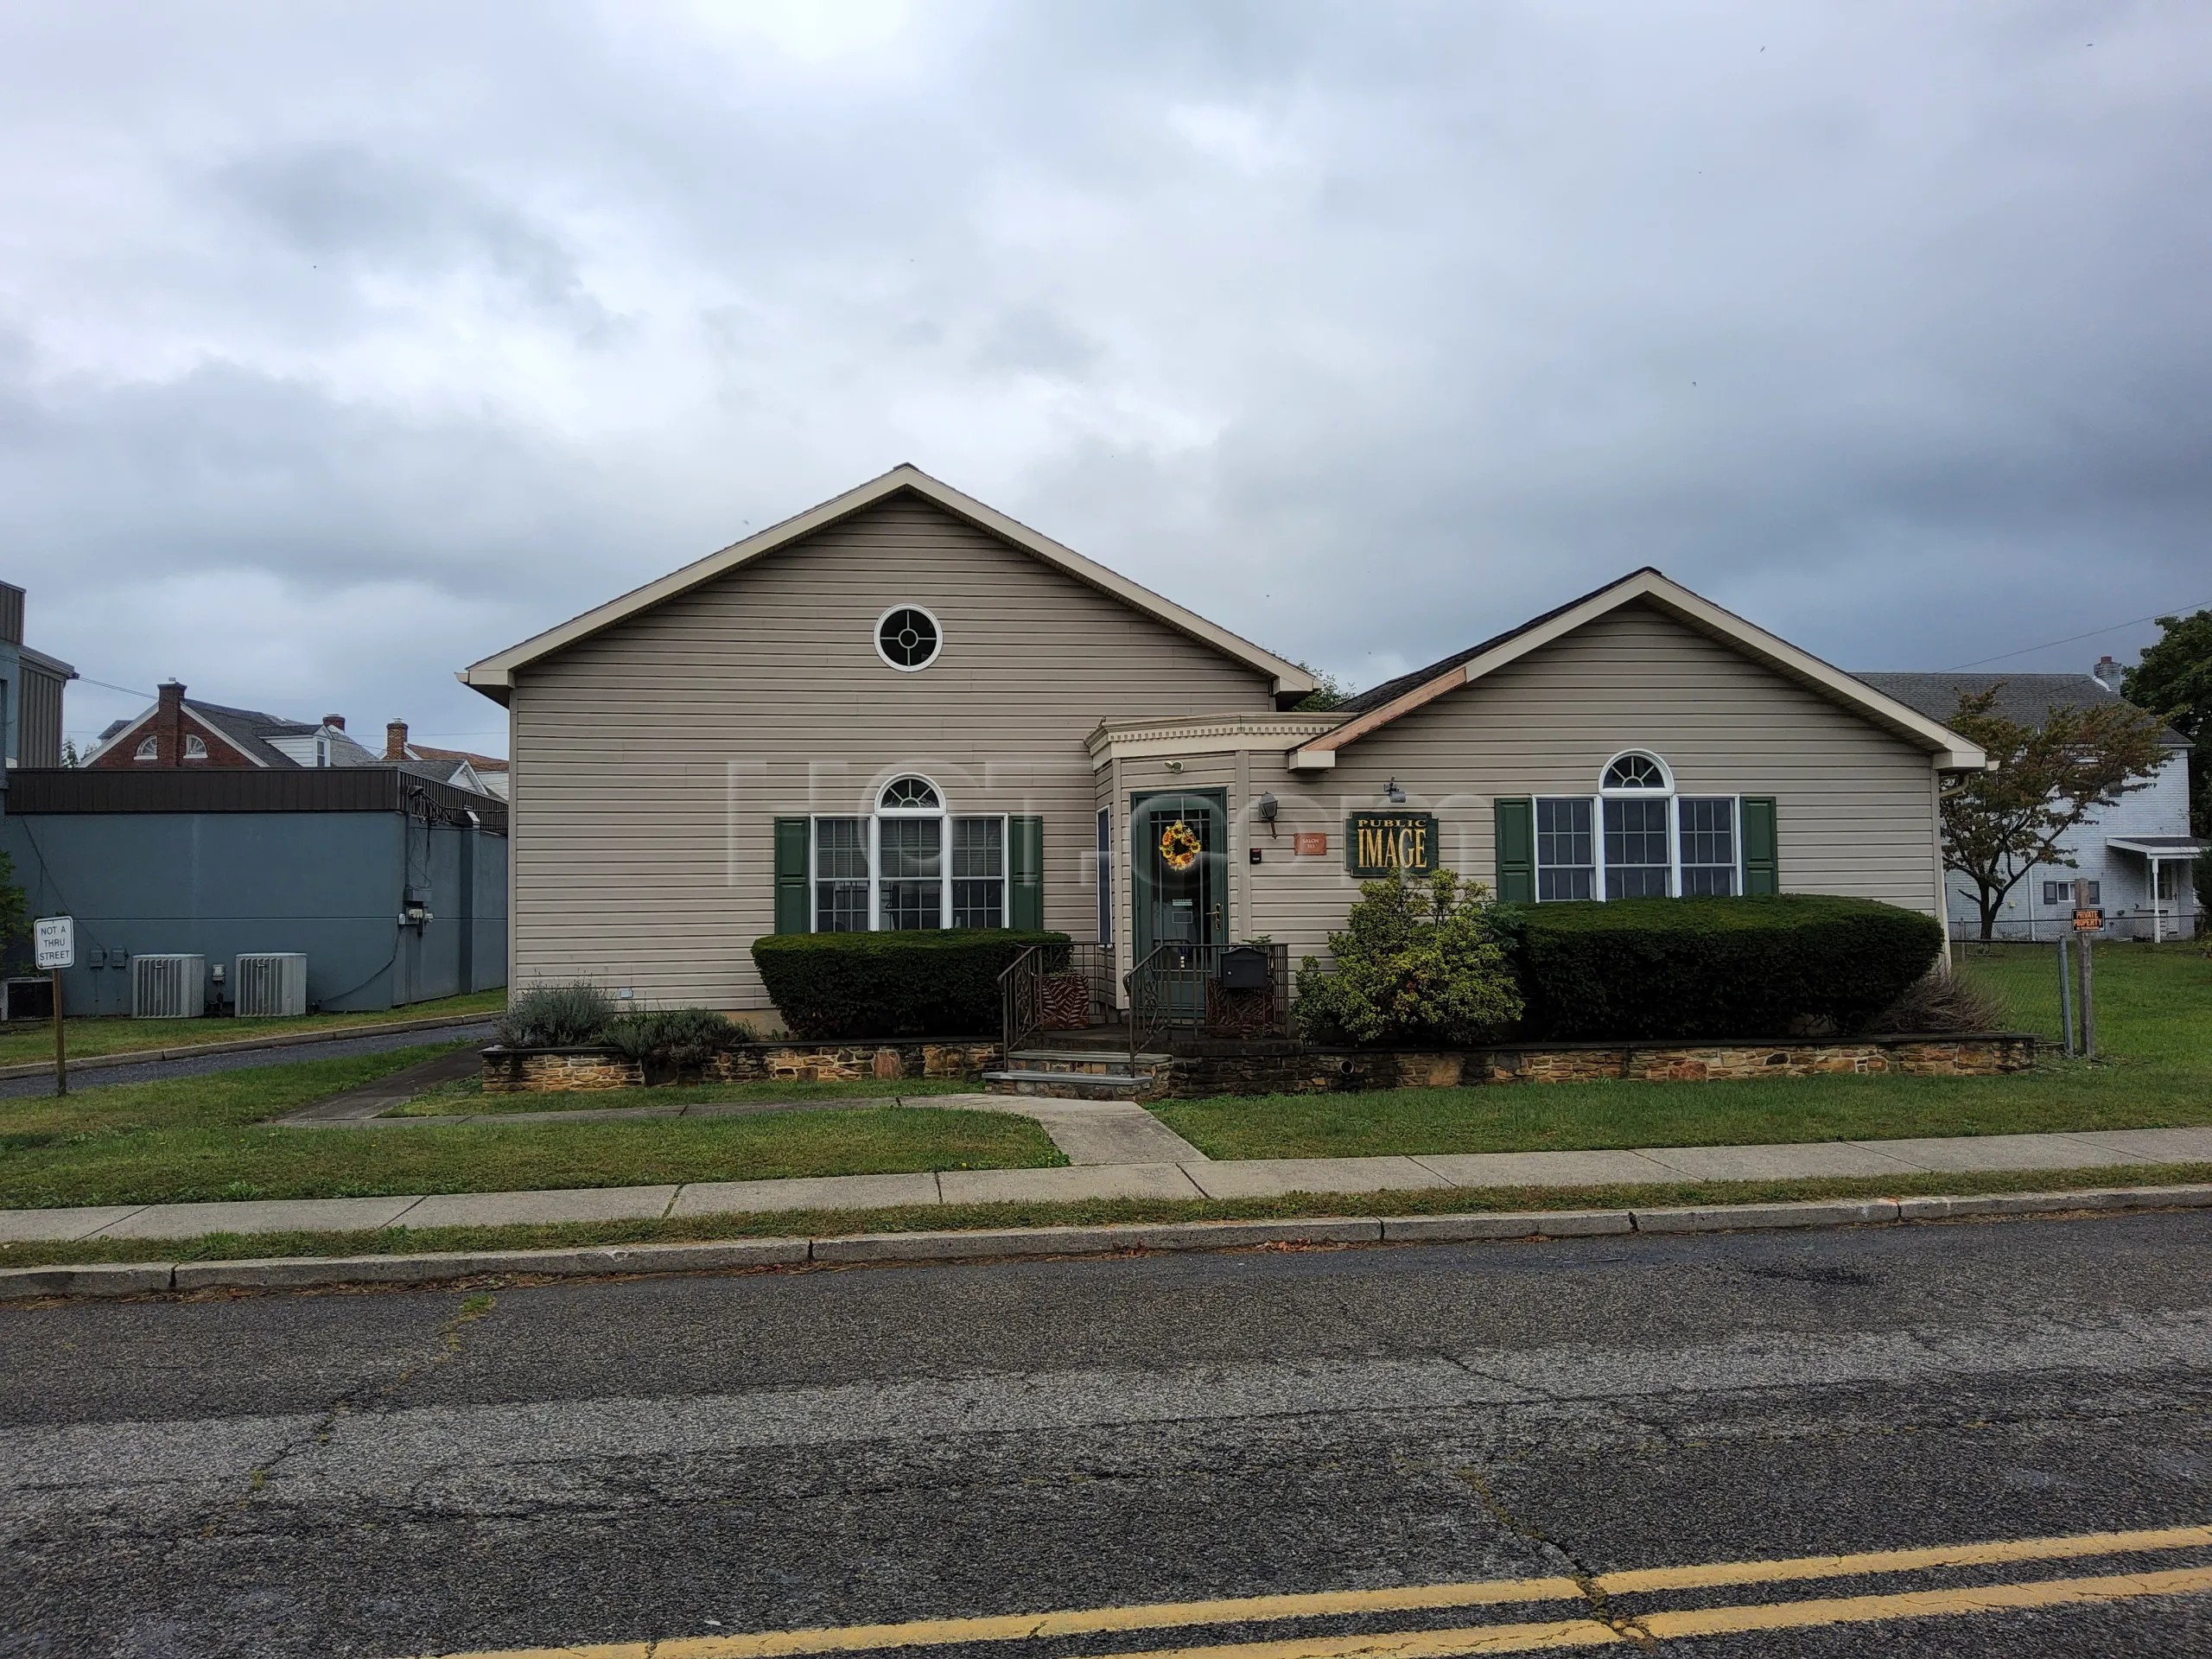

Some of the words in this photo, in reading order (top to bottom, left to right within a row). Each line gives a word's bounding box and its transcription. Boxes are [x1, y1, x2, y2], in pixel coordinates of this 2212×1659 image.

[1357, 819, 1427, 828] PUBLIC
[1357, 828, 1427, 868] IMAGE
[41, 925, 57, 935] NOT
[43, 938, 65, 947] THRU
[39, 950, 69, 960] STREET
